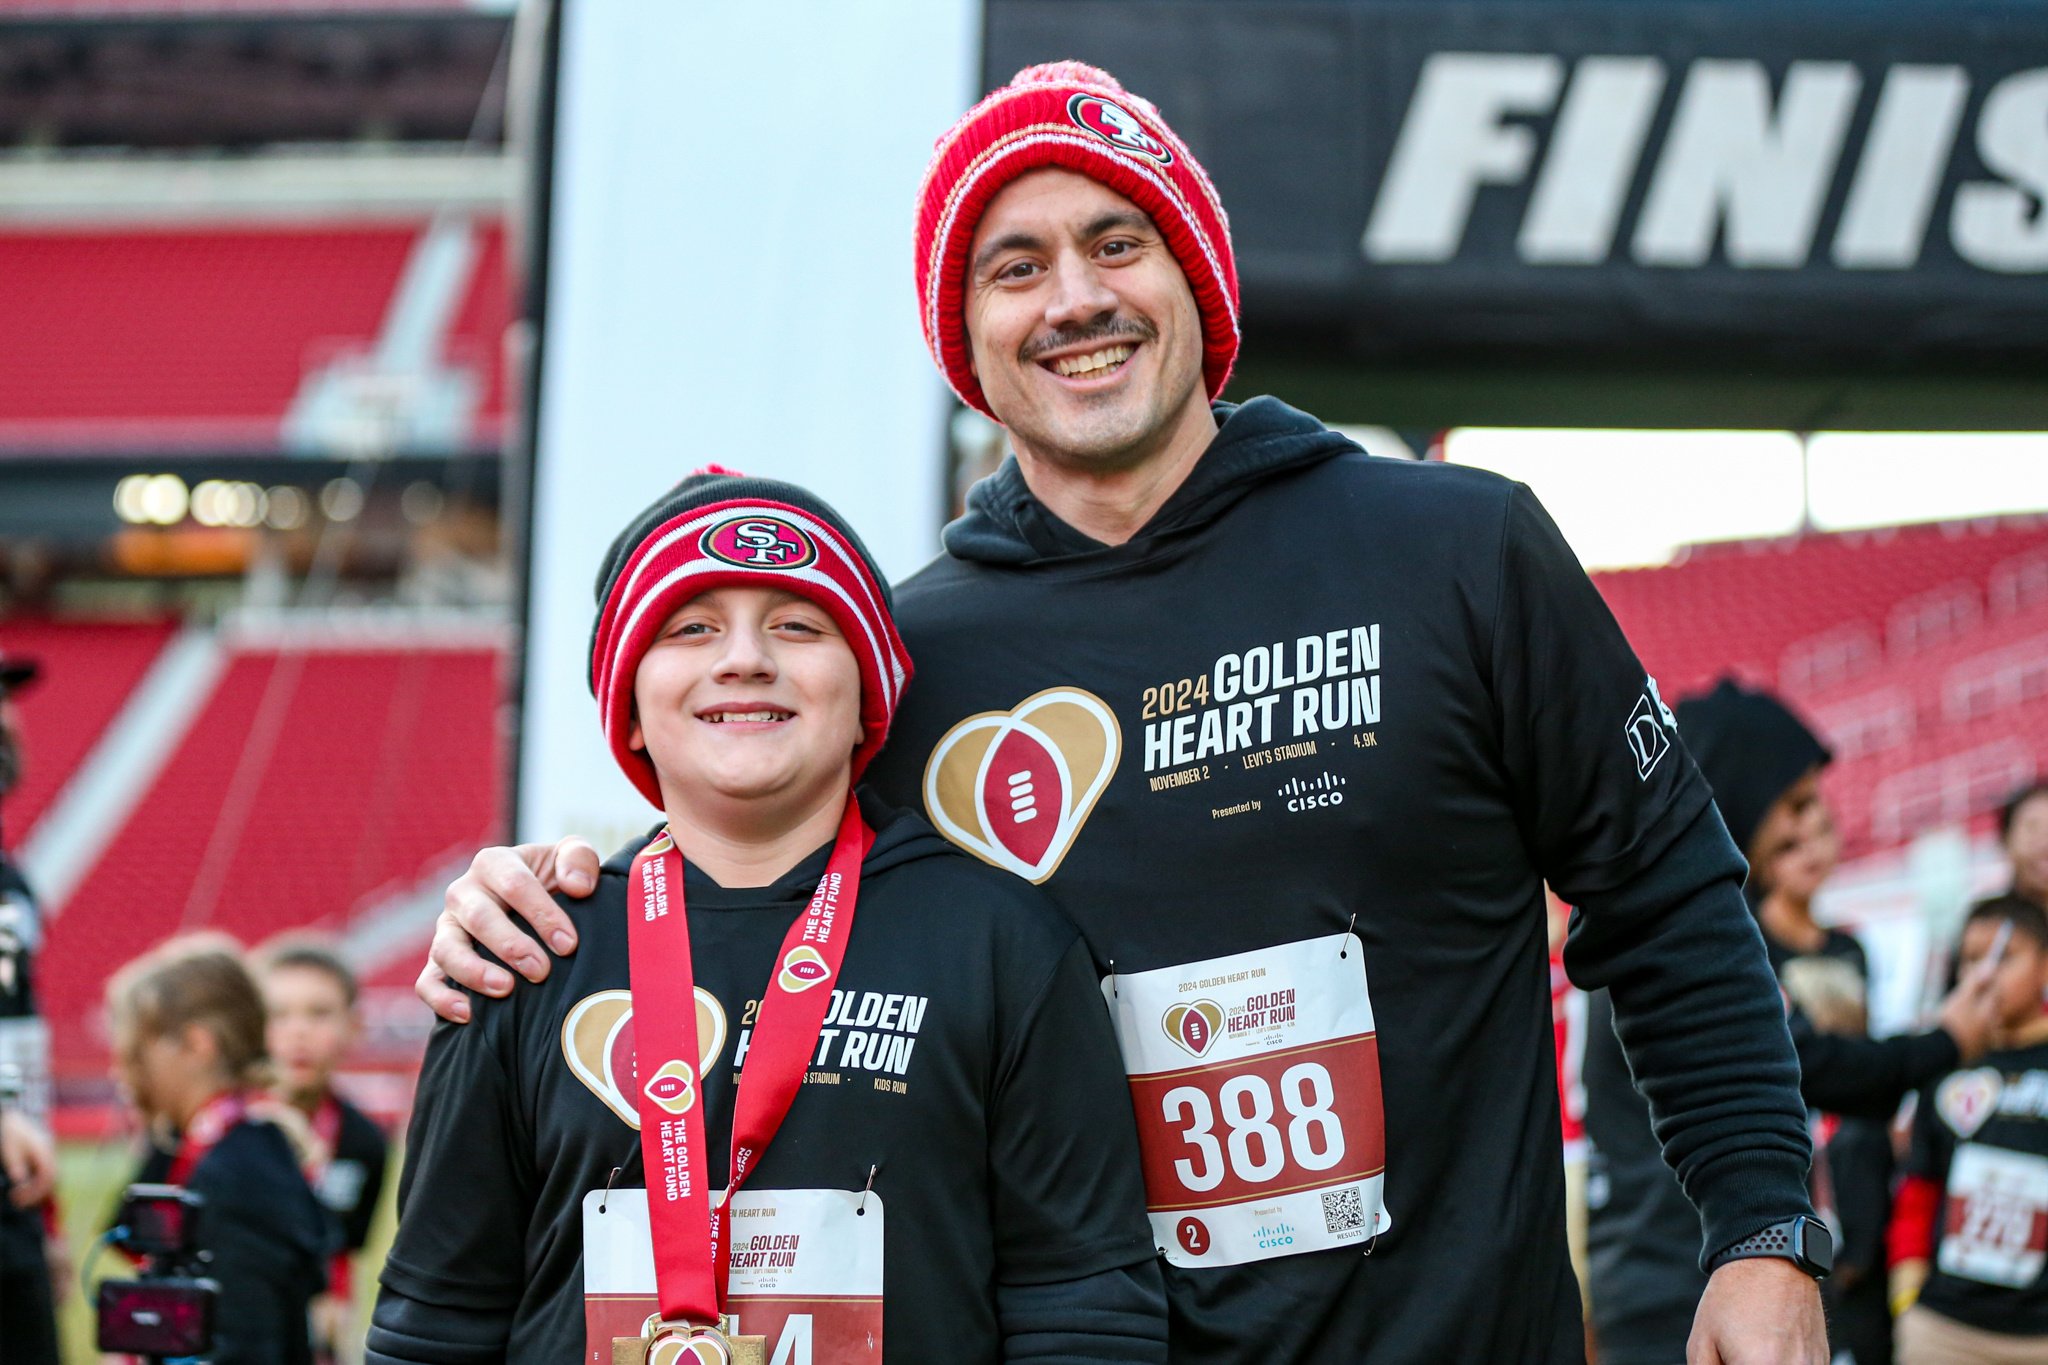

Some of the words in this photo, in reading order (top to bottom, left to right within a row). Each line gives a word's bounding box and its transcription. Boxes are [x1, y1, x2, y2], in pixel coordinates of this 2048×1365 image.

[1142, 674, 1209, 720] 2024
[1213, 623, 1380, 702] GOLDEN
[1144, 693, 1280, 772] HEART
[1292, 674, 1381, 737] RUN
[1149, 772, 1201, 792] NOVEMBER
[1202, 765, 1210, 780] 2
[1242, 748, 1273, 770] LEVI'S
[1274, 740, 1317, 763] STADIUM
[1353, 731, 1378, 749] 4.9K
[1212, 801, 1250, 819] Presented
[1251, 800, 1261, 812] by
[642, 860, 654, 893] HEART
[653, 856, 665, 877] THE
[644, 893, 656, 922] FUND
[655, 876, 668, 917] GOLDEN
[816, 902, 836, 943] HEART
[826, 872, 842, 903] FUND
[802, 918, 819, 941] THE
[1178, 981, 1197, 993] 2024
[1199, 976, 1226, 989] GOLDEN
[1227, 971, 1249, 983] HEART
[1251, 968, 1266, 978] RUN
[823, 989, 929, 1034] OLDEN
[1229, 1005, 1246, 1017] 2024
[1247, 988, 1295, 1012] GOLDEN
[1227, 1011, 1266, 1033] HEART
[1270, 1005, 1295, 1025] RUN
[839, 1030, 916, 1075] RUN
[809, 1072, 840, 1085] STADIUM
[874, 1077, 891, 1092] KIDS
[892, 1080, 907, 1094] RUN
[673, 1118, 687, 1145] THE
[1162, 1062, 1345, 1192] 388
[660, 1121, 675, 1164] HEART
[664, 1166, 678, 1202] FUND
[676, 1146, 691, 1198] GOLDEN
[738, 1208, 760, 1218] HEART
[761, 1208, 776, 1217] RUN
[732, 1242, 749, 1251] 2024
[750, 1235, 800, 1251] GOLDEN
[1186, 1224, 1201, 1248] 2
[1336, 1230, 1363, 1240] RESULTS
[730, 1252, 767, 1268] HEART
[768, 1252, 796, 1267] RUN
